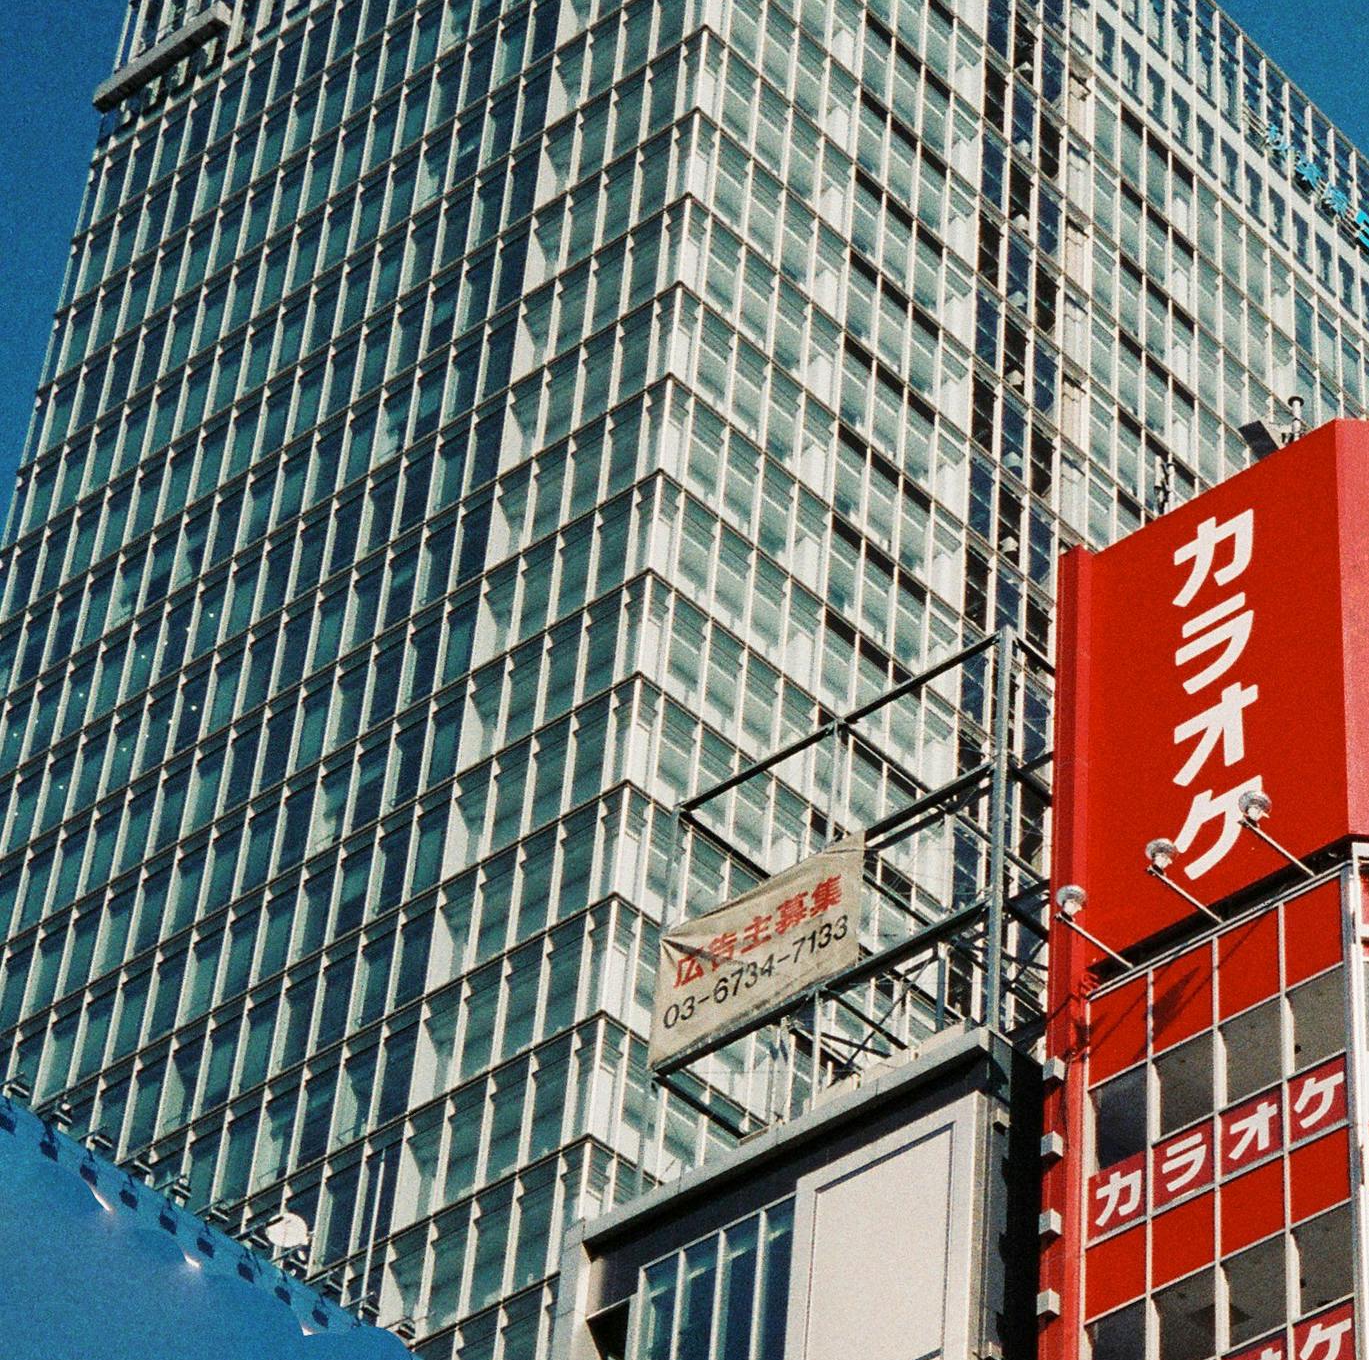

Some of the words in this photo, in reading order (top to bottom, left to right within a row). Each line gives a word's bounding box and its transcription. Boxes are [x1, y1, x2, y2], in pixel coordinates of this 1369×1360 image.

[1173, 508, 1264, 881] カラオケ
[662, 913, 849, 1031] 03-6734-7133
[673, 873, 844, 990] 広告主募集
[1095, 1069, 1345, 1227] カラオケ
